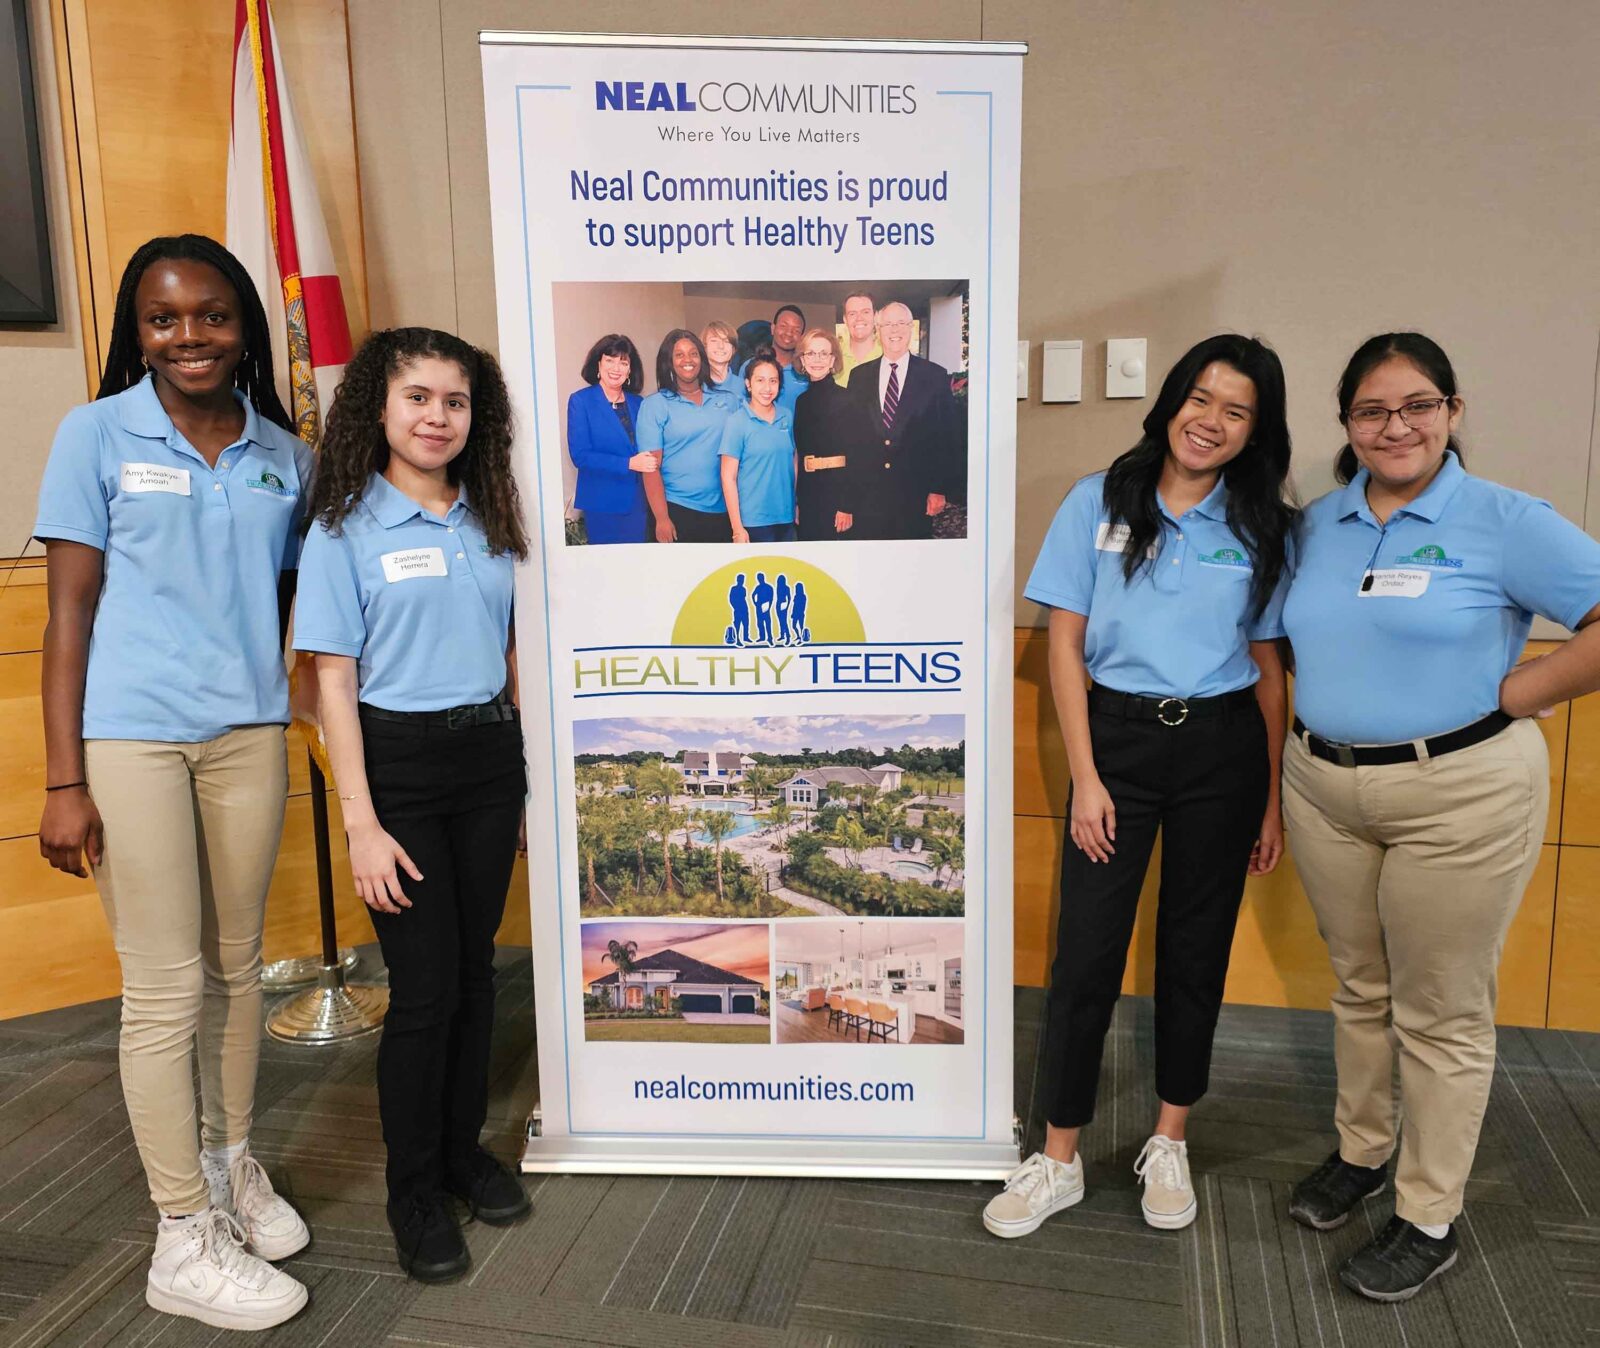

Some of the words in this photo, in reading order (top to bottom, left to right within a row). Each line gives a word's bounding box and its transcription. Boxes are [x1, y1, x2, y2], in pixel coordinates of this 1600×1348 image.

[657, 126, 714, 142] Where
[720, 126, 752, 143] You
[759, 126, 791, 143] Live
[797, 127, 861, 144] Matters
[570, 169, 634, 202] Neal
[642, 169, 829, 202] Communities
[837, 169, 860, 202] is
[868, 170, 948, 209] proud
[585, 218, 615, 247] to
[623, 218, 736, 254] support
[744, 215, 849, 254] Healthy
[855, 215, 935, 247] Teens
[125, 469, 144, 478] Amy
[400, 562, 429, 571] Herrera
[573, 654, 794, 689] HEALTHY
[799, 651, 962, 685] TEENS
[634, 1074, 914, 1102] nealcommunities.com
